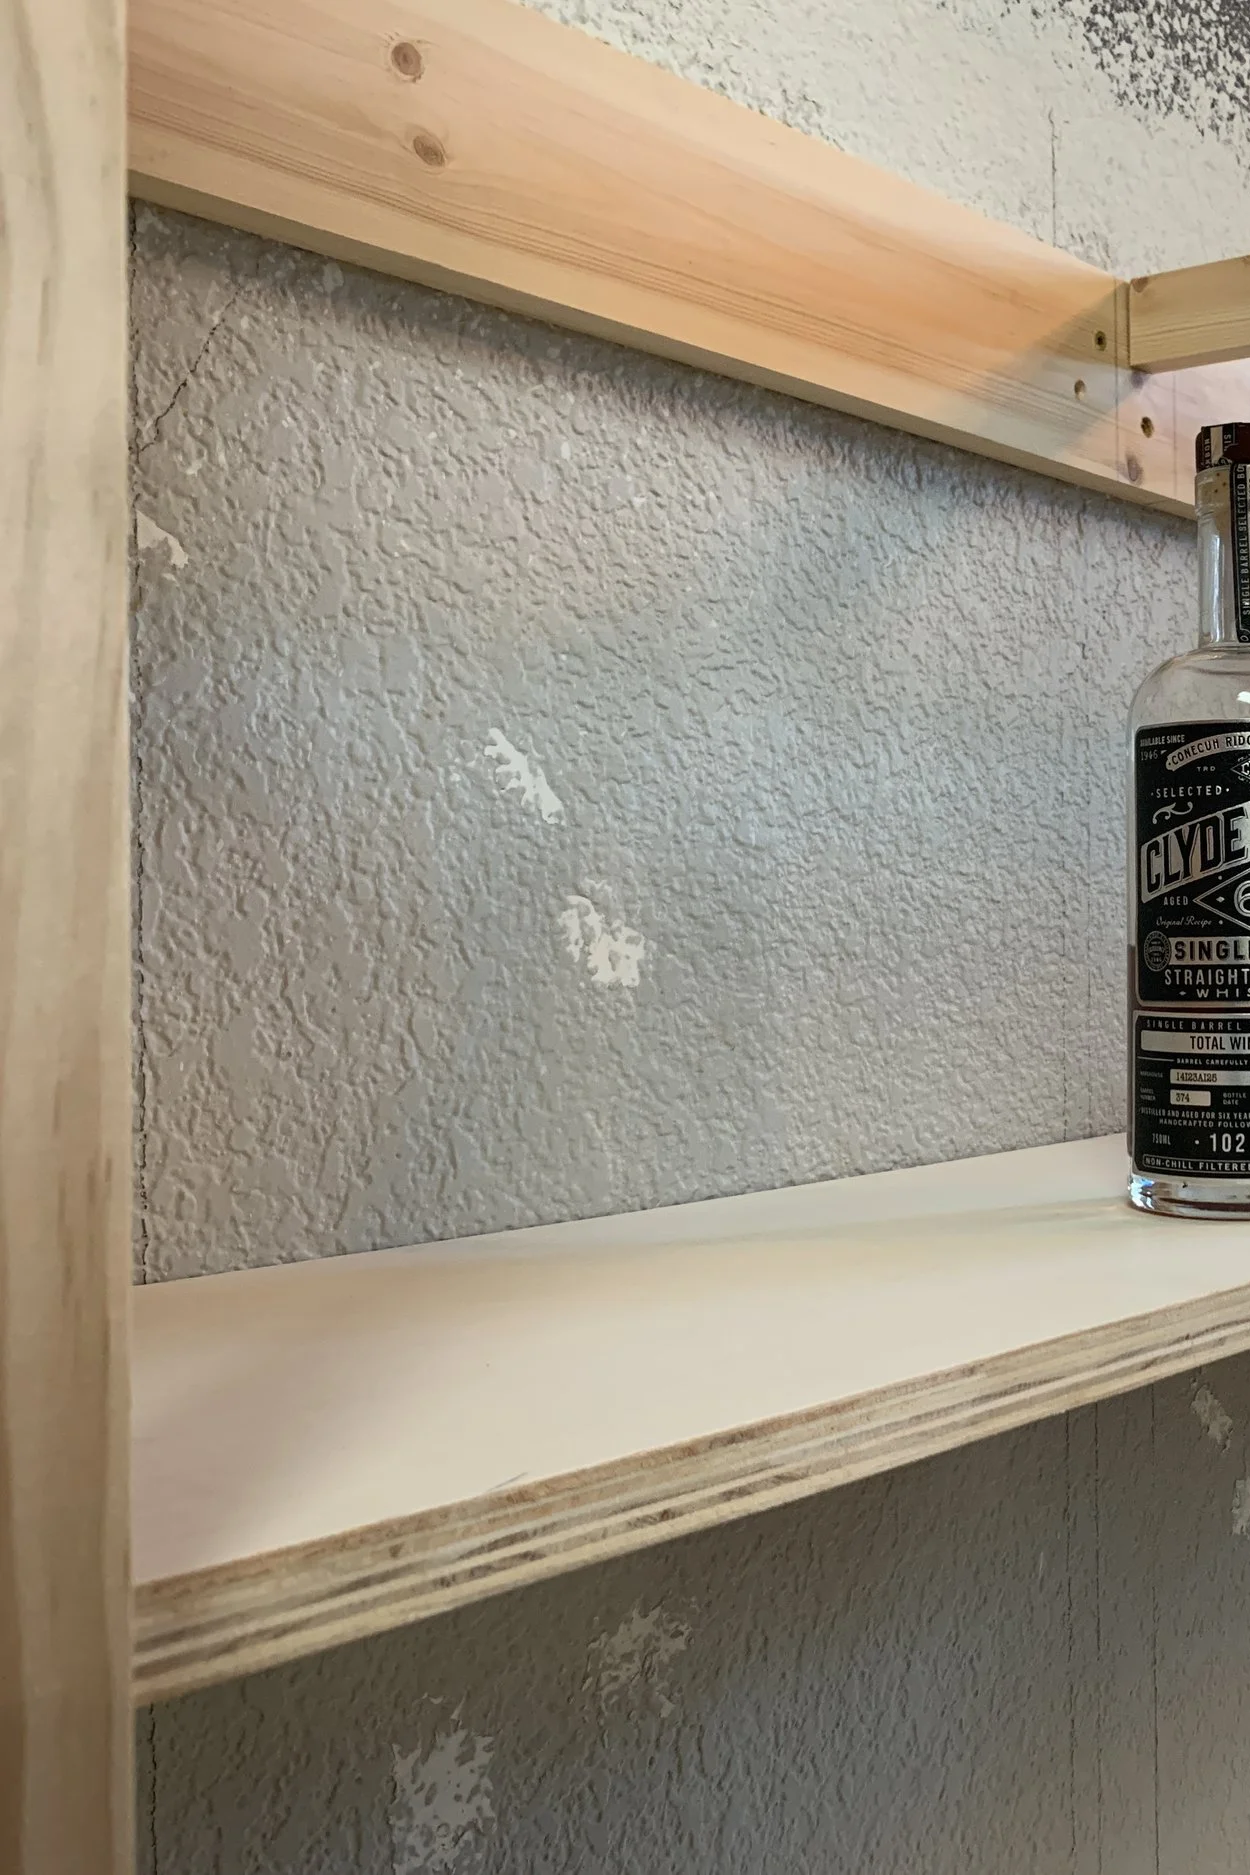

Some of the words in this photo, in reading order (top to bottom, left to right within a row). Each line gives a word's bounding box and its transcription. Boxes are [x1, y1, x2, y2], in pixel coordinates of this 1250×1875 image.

[1237, 483, 1247, 532] SELECTED
[1239, 535, 1250, 574] BARREL
[1241, 578, 1250, 615] SINGLE
[1166, 734, 1185, 744] SINCE
[1171, 739, 1220, 765] CONECUH
[1156, 785, 1223, 799] SELECTED
[1145, 806, 1250, 894] CLYDE
[1163, 895, 1189, 906] AGED
[1164, 968, 1250, 986] STRAIGHT
[1146, 1019, 1184, 1030] SINGLE
[1191, 1021, 1242, 1031] BARREL
[1189, 1035, 1226, 1050] TOTAL
[1205, 1058, 1249, 1066] CAREFULLY
[1175, 1092, 1190, 1103] 374
[1167, 1109, 1180, 1118] AND
[1181, 1110, 1199, 1119] AGED
[1201, 1111, 1216, 1120] FOR
[1218, 1112, 1231, 1120] SIX
[1160, 1118, 1214, 1127] HANDCRAFTED
[1209, 1132, 1246, 1153] 102
[1145, 1156, 1194, 1170] NON-CHILL
